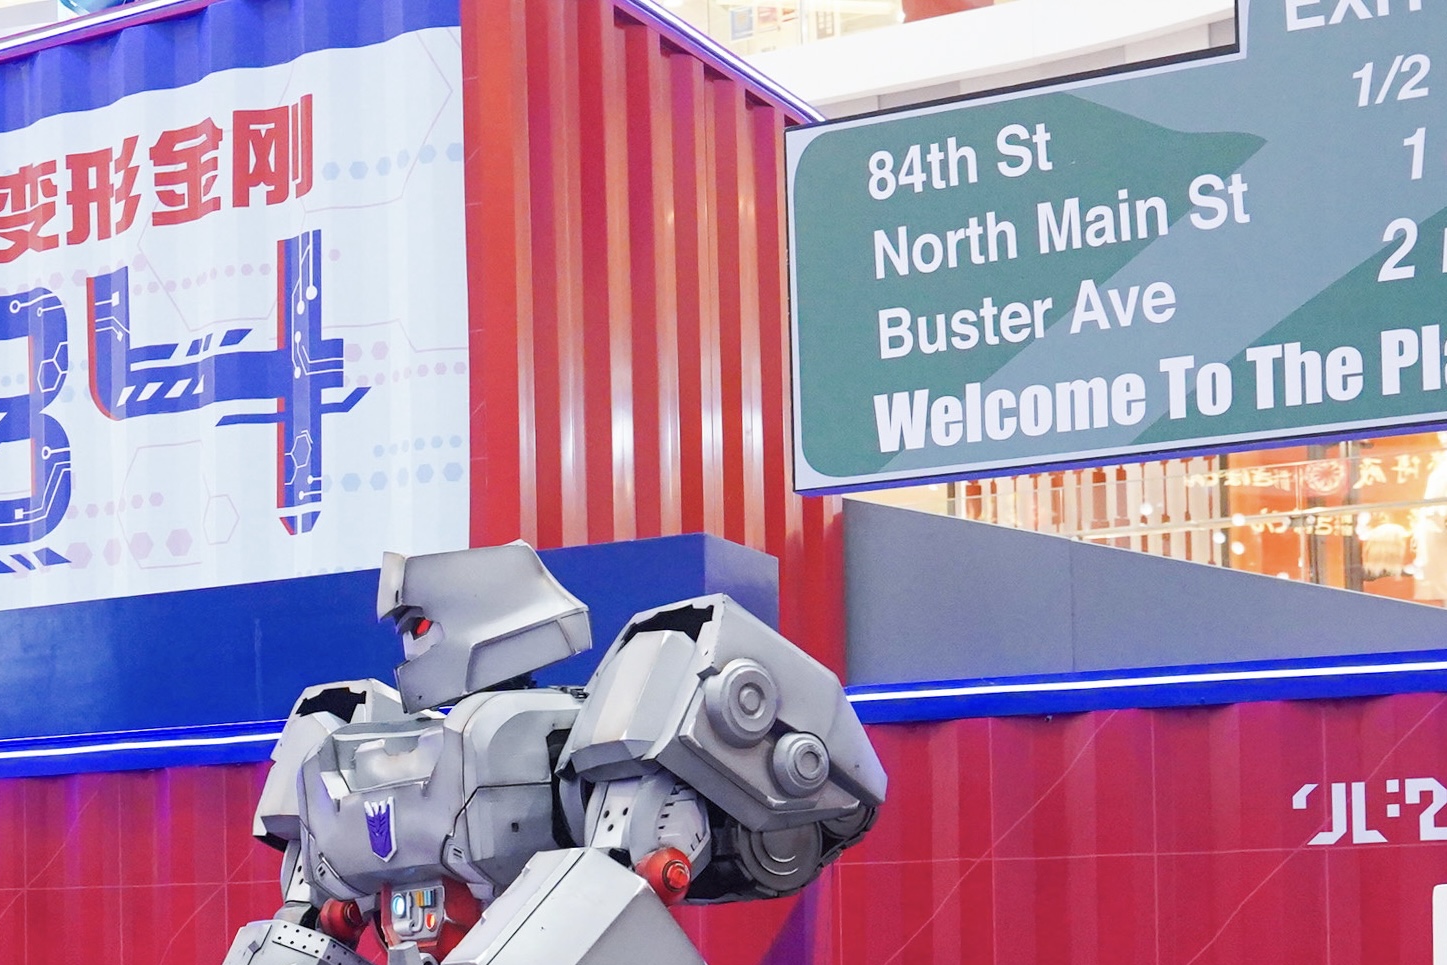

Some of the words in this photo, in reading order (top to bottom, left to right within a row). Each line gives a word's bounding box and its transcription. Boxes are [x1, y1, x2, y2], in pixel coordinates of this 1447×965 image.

[1352, 53, 1432, 108] 1/2
[867, 137, 979, 201] 84th
[996, 122, 1053, 178] St
[1402, 127, 1427, 181] 1
[873, 211, 1018, 280] North
[1037, 188, 1169, 255] Main
[1188, 173, 1250, 230] St
[1376, 217, 1419, 283] 2
[878, 296, 1053, 360] Buster
[1069, 279, 1177, 334] Ave
[873, 367, 1147, 453] Welcome
[1159, 354, 1233, 420] To
[1246, 341, 1364, 410] The
[1380, 323, 1447, 396] Pl
